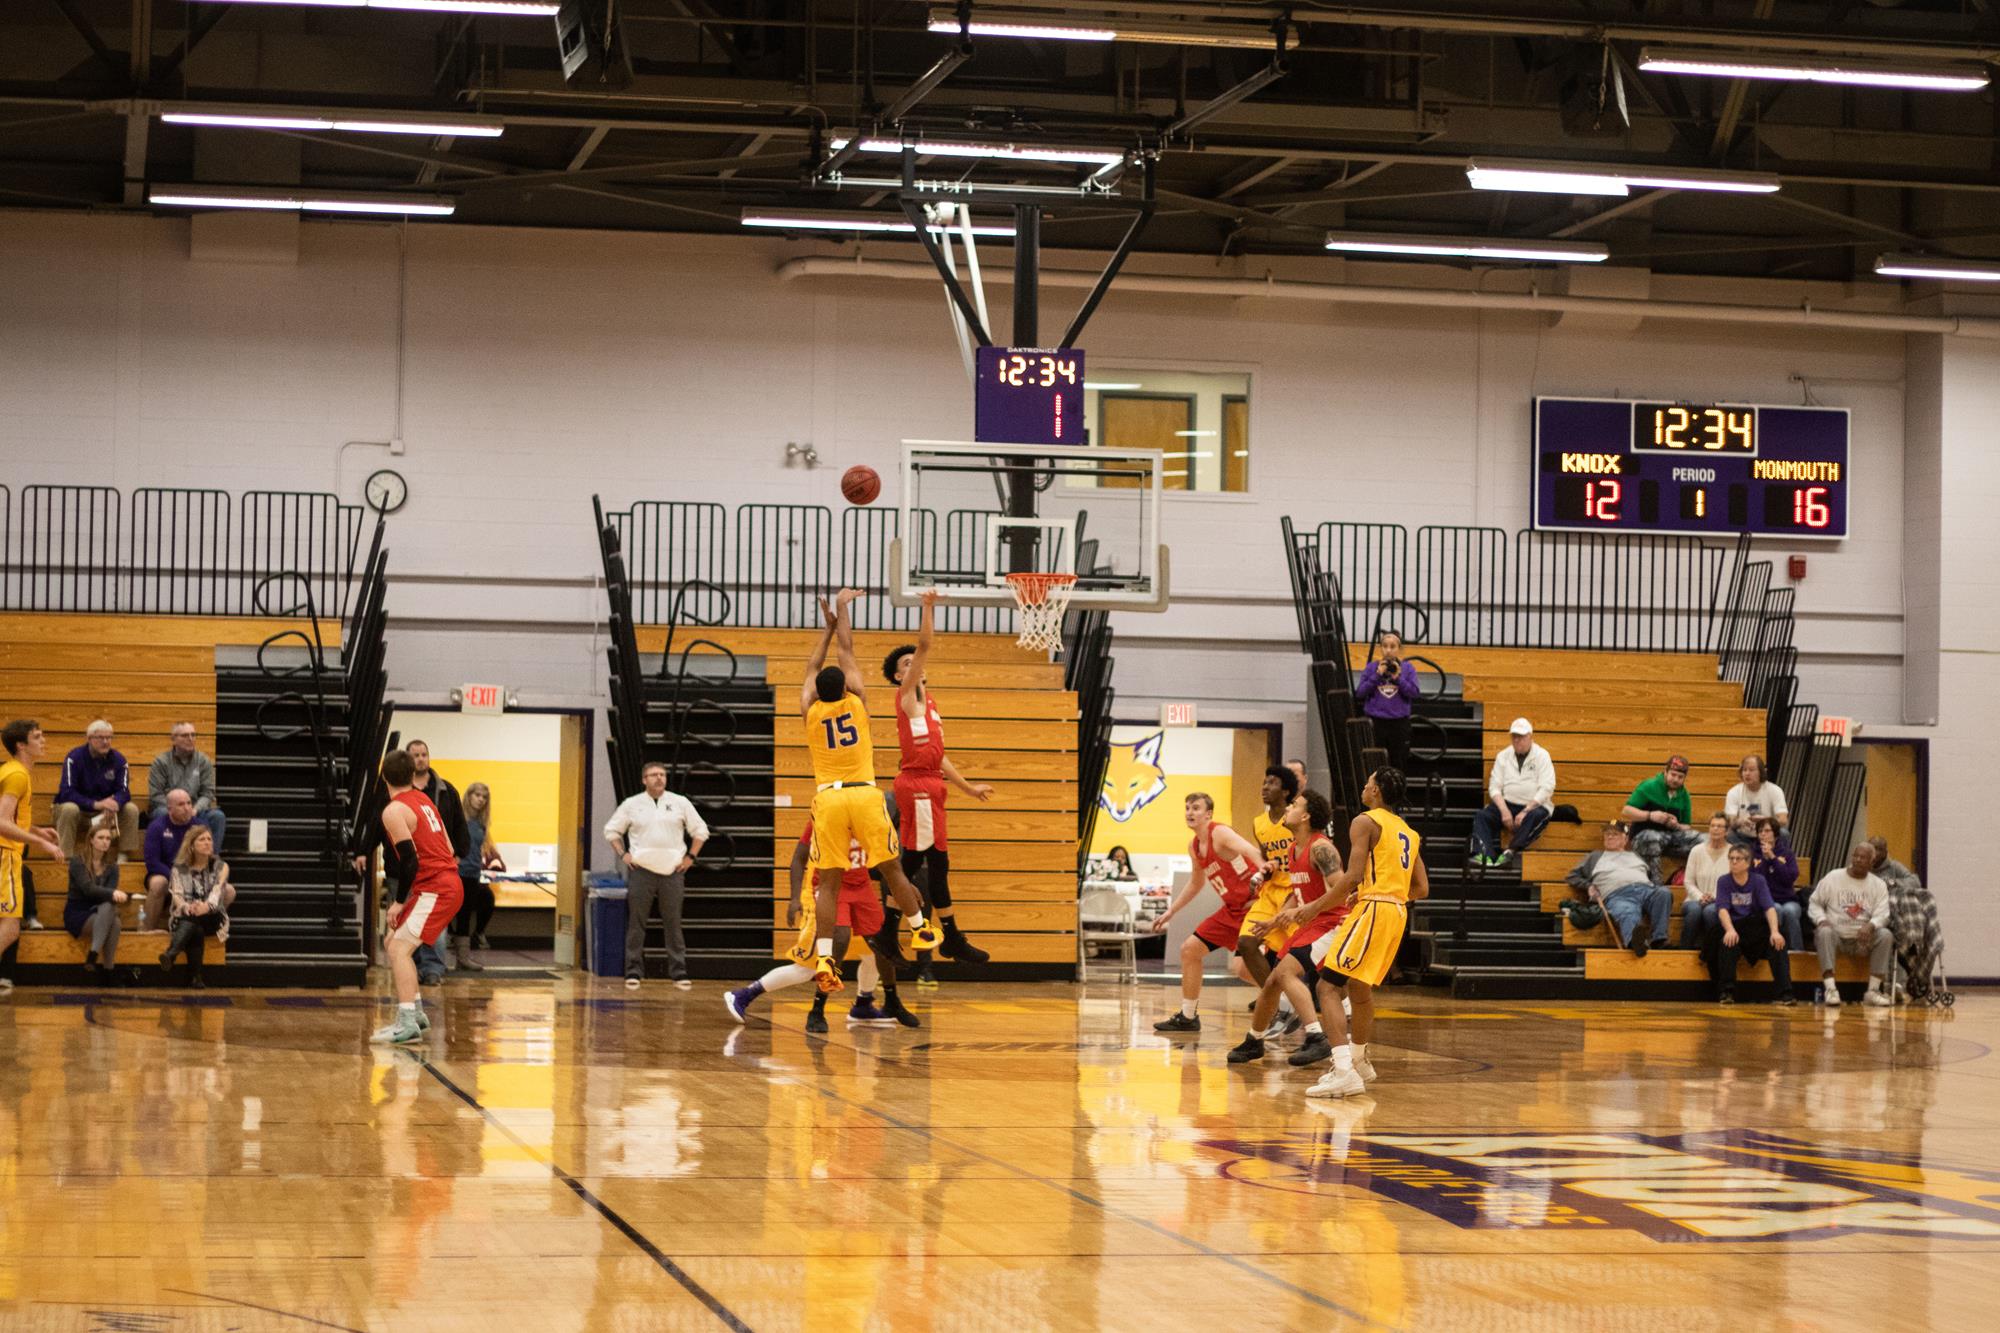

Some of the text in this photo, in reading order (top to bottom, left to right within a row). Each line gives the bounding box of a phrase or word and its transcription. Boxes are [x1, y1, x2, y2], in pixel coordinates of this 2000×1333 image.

[999, 356, 1076, 387] 12:34
[1055, 394, 1061, 438] 1
[1655, 407, 1752, 449] 12:34
[1562, 452, 1622, 474] KNOX
[1672, 468, 1716, 482] PERIOD
[1753, 460, 1840, 481] MONMOUTH
[1585, 480, 1621, 520] 12
[1695, 489, 1705, 517] 1
[1794, 488, 1830, 527] 16
[471, 687, 497, 706] EXIT
[1167, 704, 1192, 724] EXIT
[1822, 719, 1846, 737] EXIT
[821, 712, 858, 749] 15
[850, 849, 866, 869] 21
[1398, 832, 1410, 869] 3
[1342, 957, 1354, 969] K
[1350, 1136, 2000, 1237] KNOX
